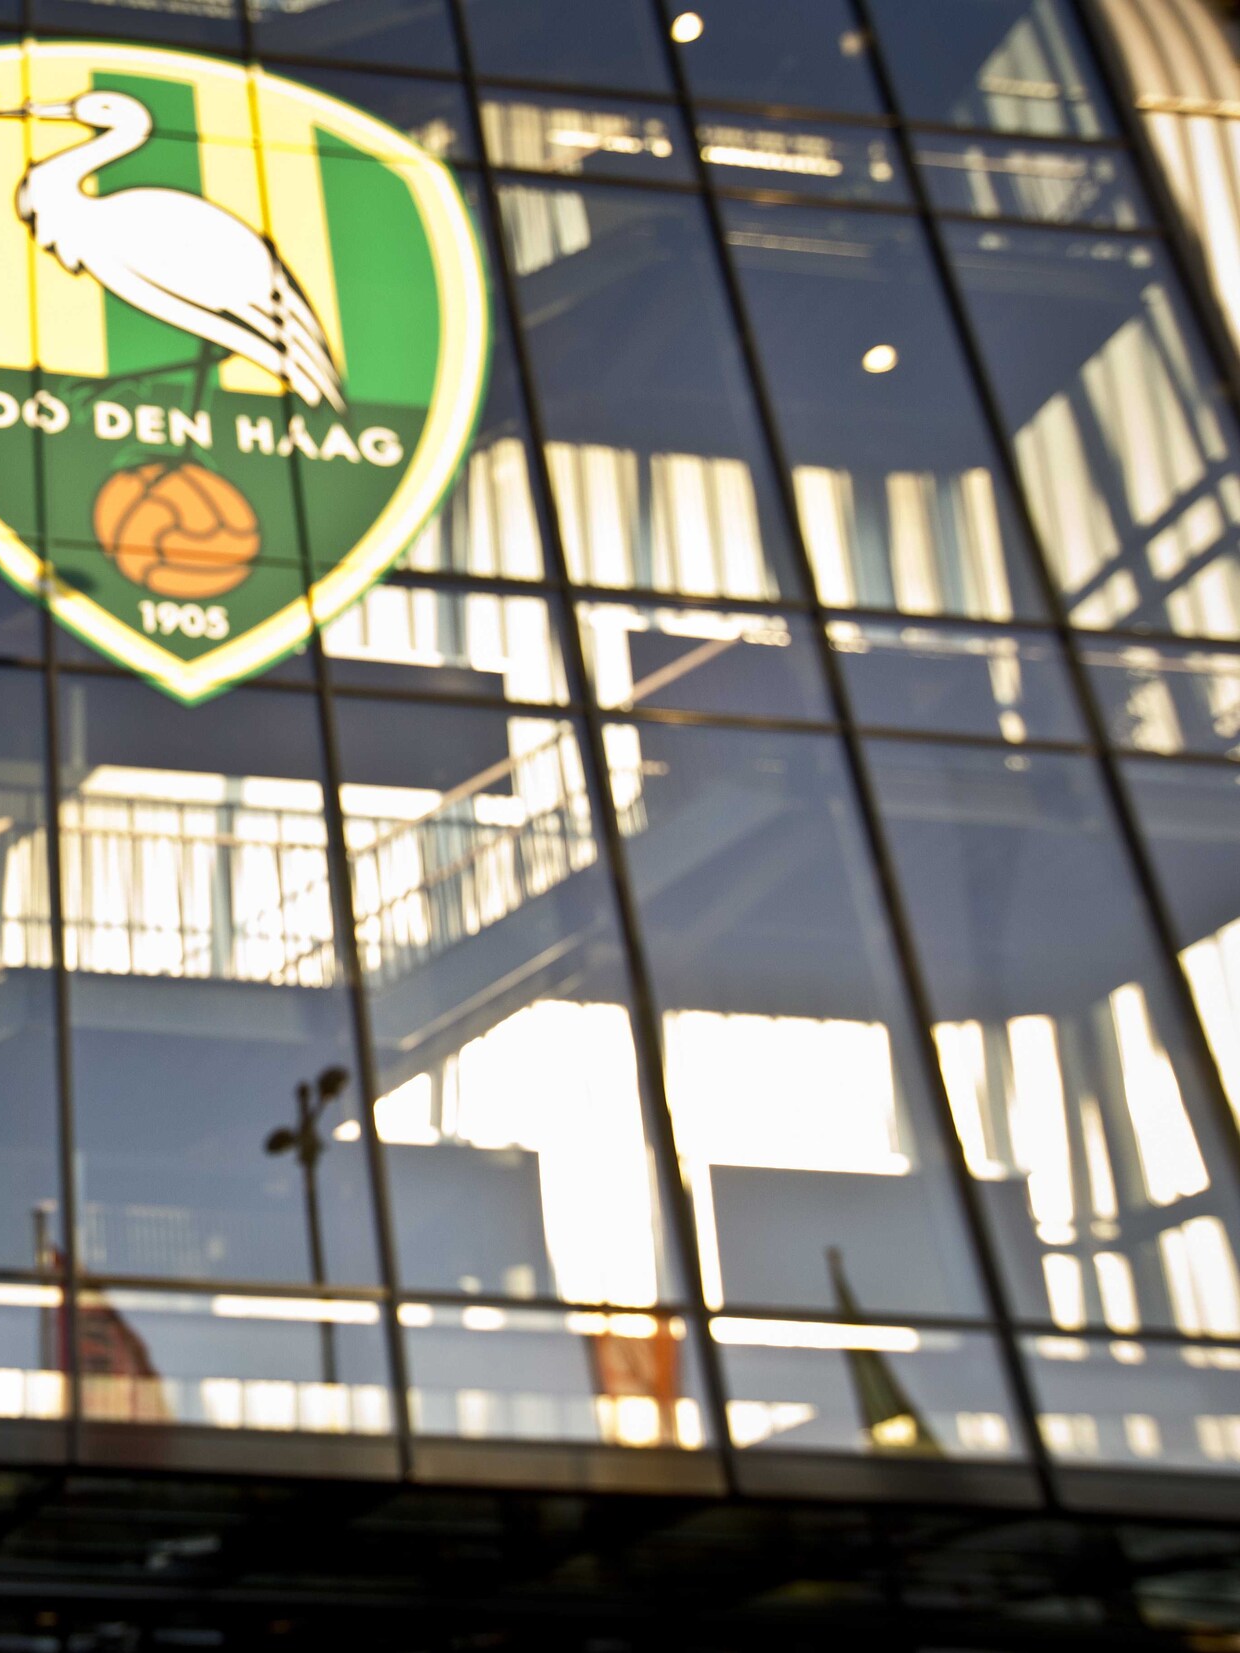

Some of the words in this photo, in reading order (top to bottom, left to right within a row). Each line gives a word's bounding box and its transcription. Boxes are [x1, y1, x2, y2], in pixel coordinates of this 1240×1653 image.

[93, 400, 212, 449] DEN
[235, 414, 404, 467] HAAG
[138, 599, 230, 640] 1905
